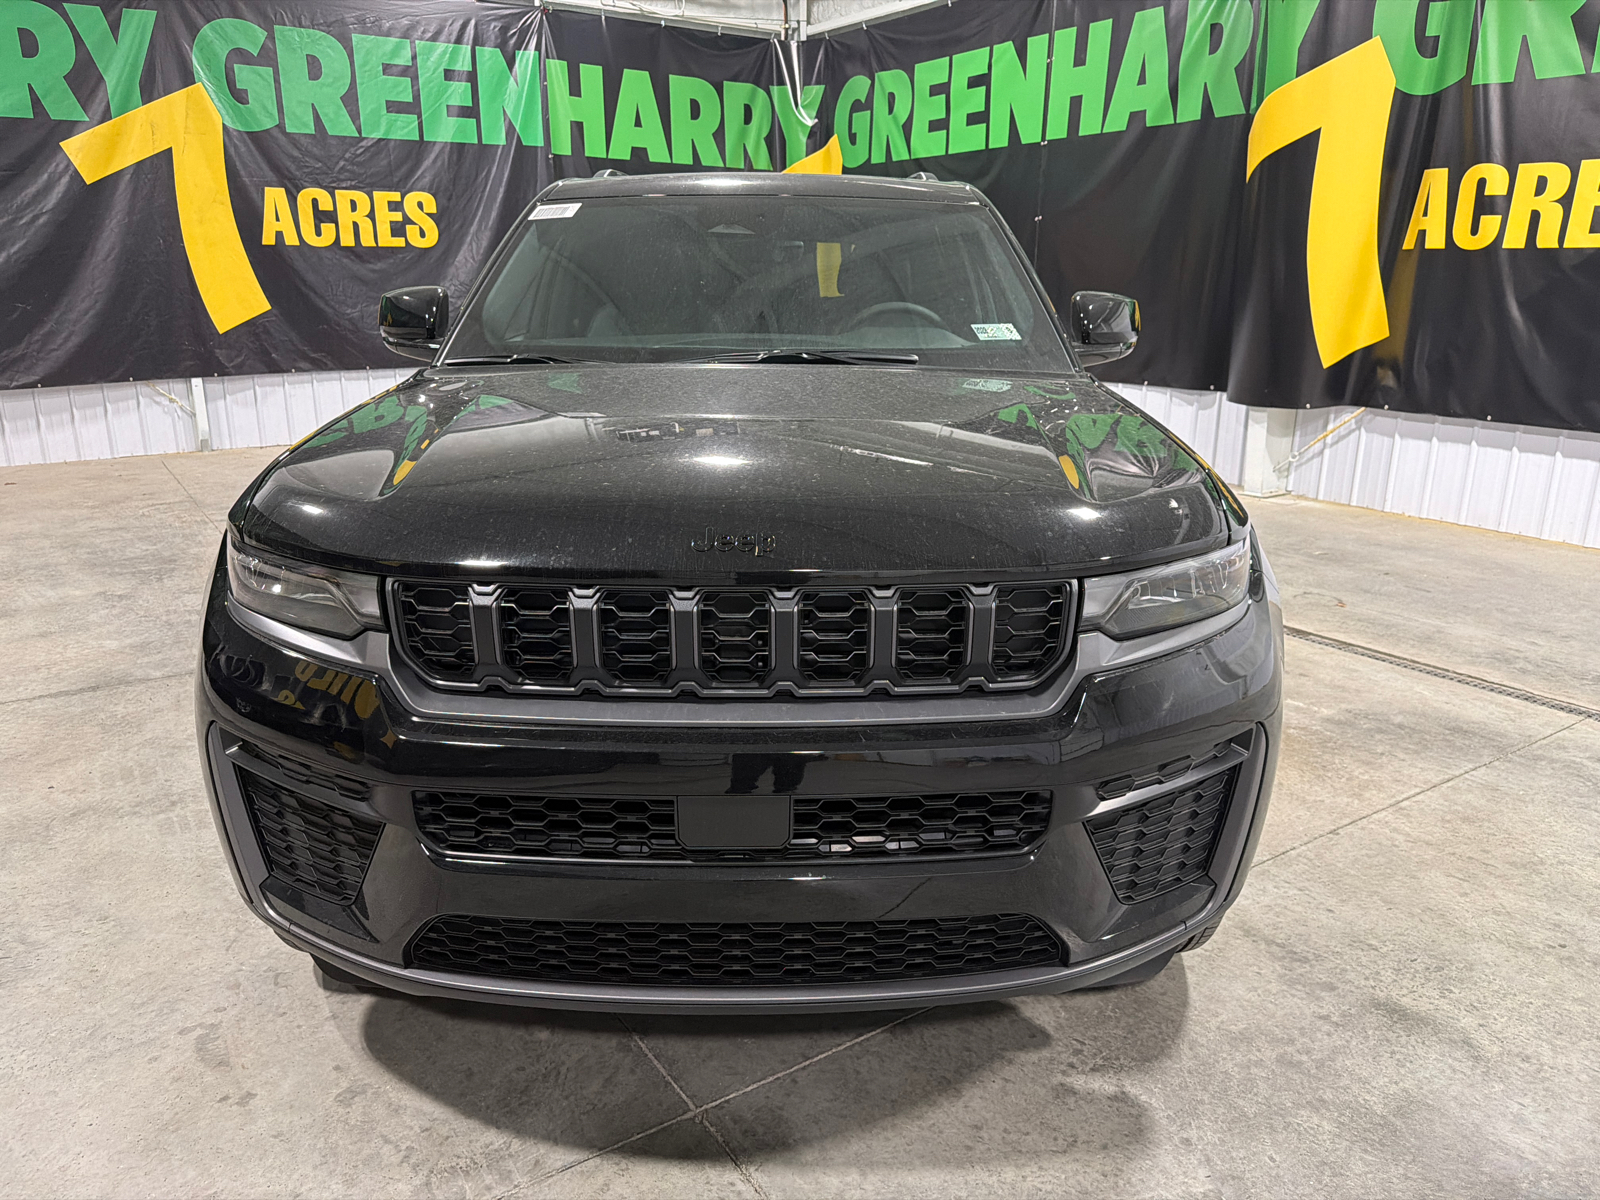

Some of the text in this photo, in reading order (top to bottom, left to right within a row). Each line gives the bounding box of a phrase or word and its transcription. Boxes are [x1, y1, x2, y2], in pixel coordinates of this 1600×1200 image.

[193, 19, 545, 147] GREEN
[546, 33, 1051, 171] HARRY GREEN
[60, 83, 440, 334] 7 ACRES
[1247, 37, 1396, 369] 7
[690, 526, 777, 557] Jeep
